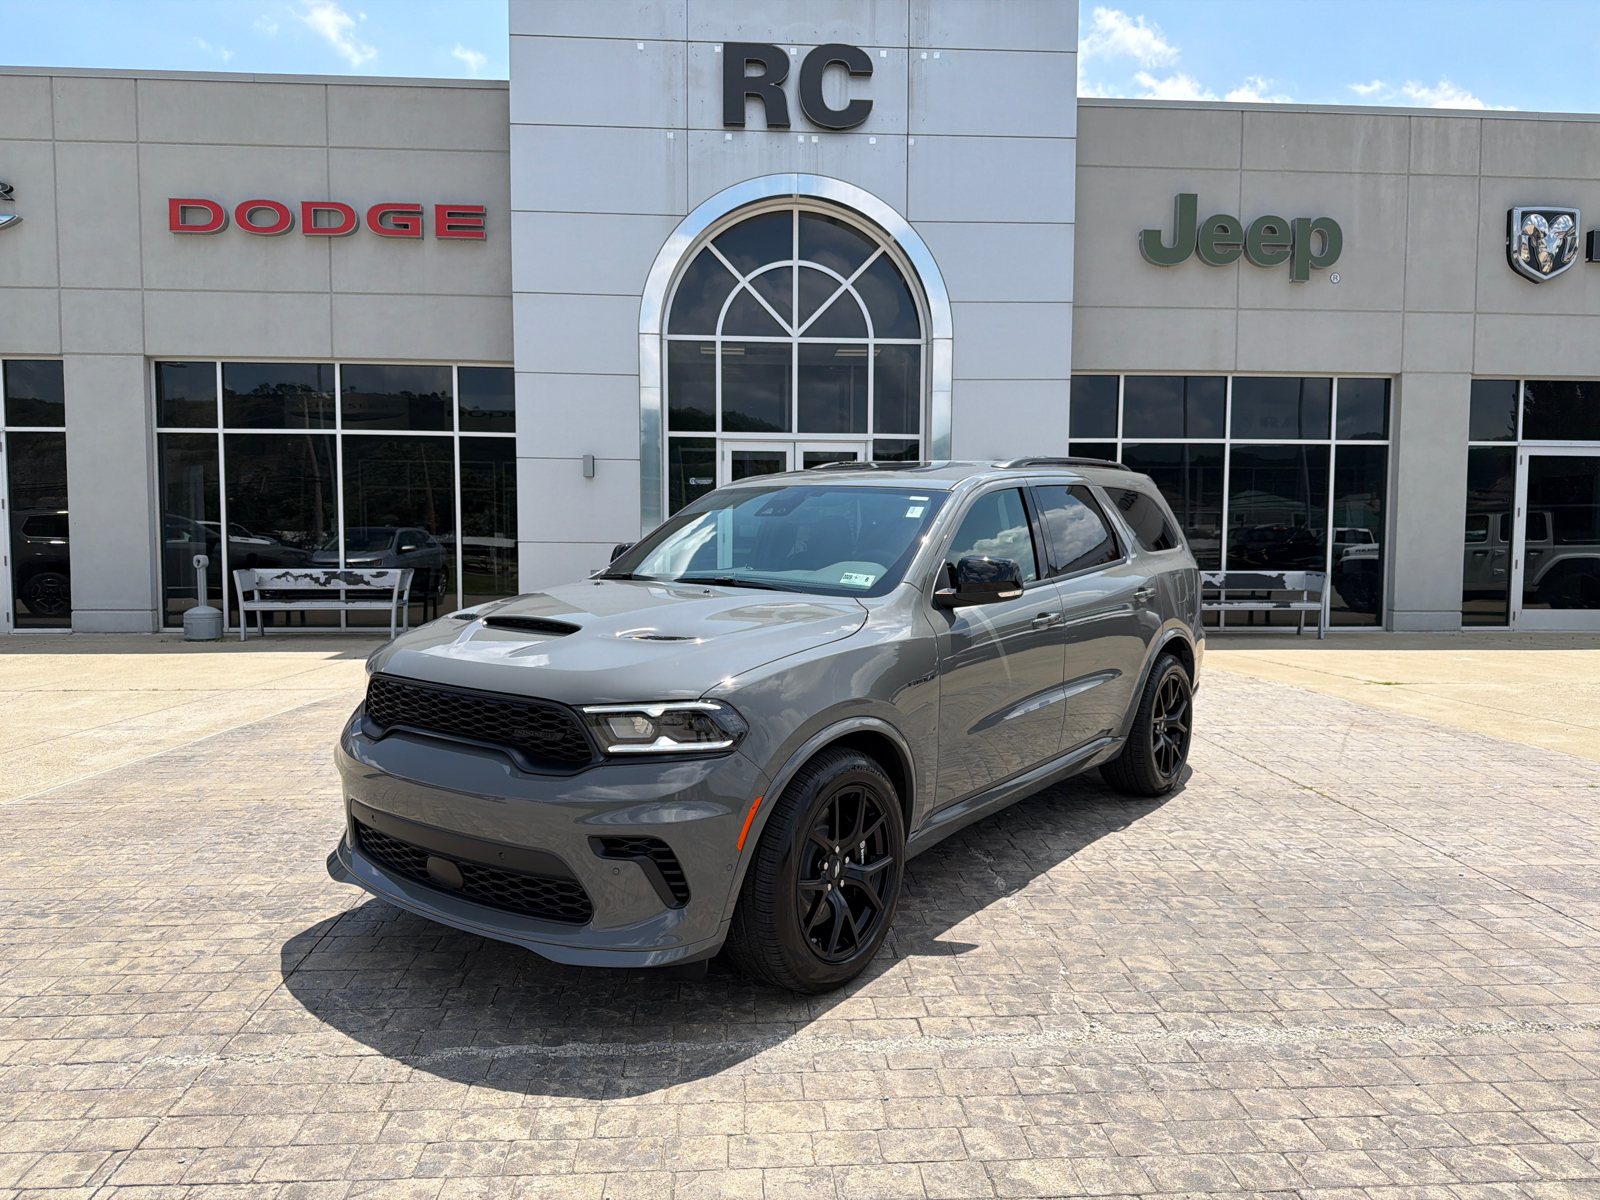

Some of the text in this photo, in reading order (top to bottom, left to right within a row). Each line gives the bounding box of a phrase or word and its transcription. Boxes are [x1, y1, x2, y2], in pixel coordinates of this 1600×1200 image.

[722, 42, 874, 131] RC
[168, 197, 487, 241] DODGE
[1138, 193, 1343, 283] Jeep
